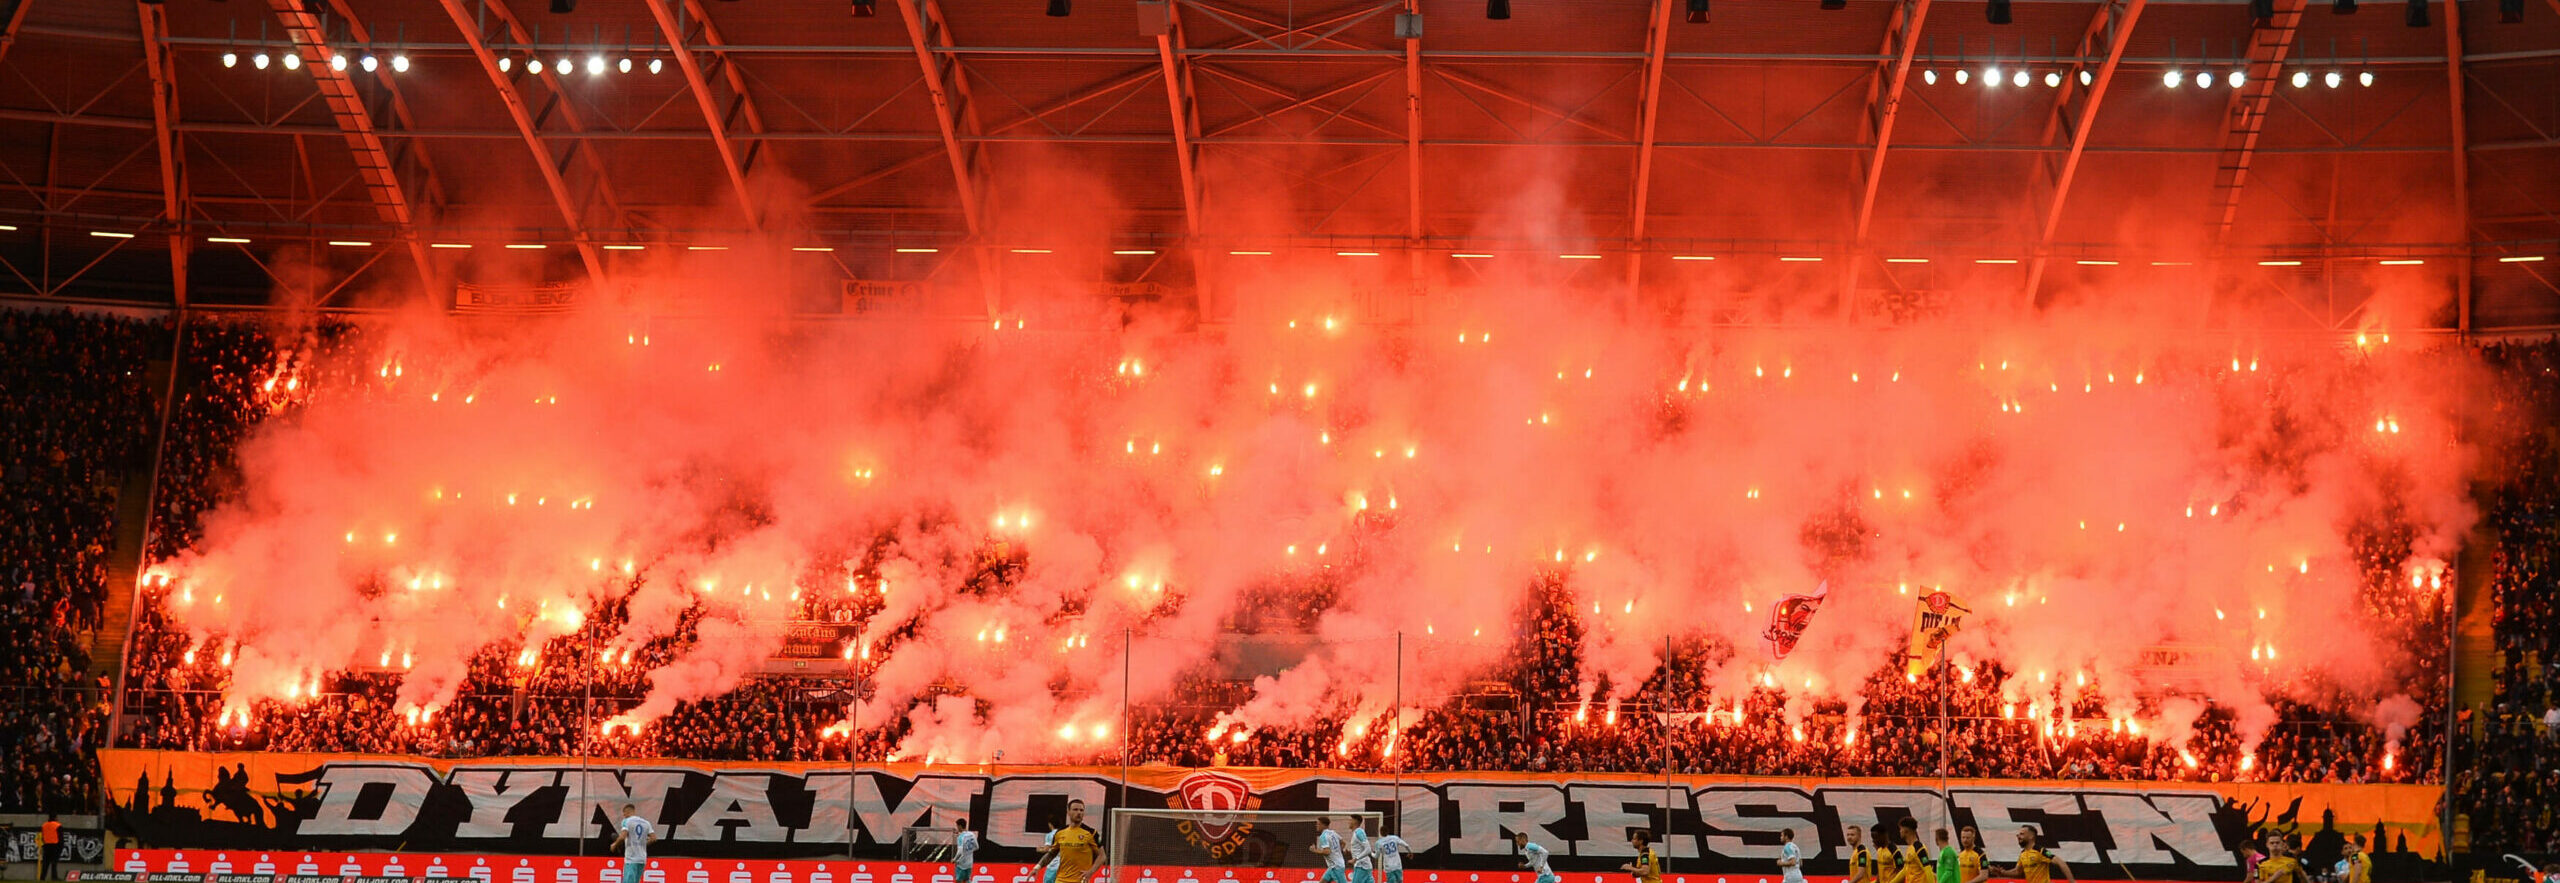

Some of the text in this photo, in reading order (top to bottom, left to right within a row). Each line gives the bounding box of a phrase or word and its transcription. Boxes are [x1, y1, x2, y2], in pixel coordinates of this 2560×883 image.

[297, 766, 2237, 867] DYNAMO DRESDEN
[635, 824, 643, 840] 9
[1383, 841, 1397, 855] 33
